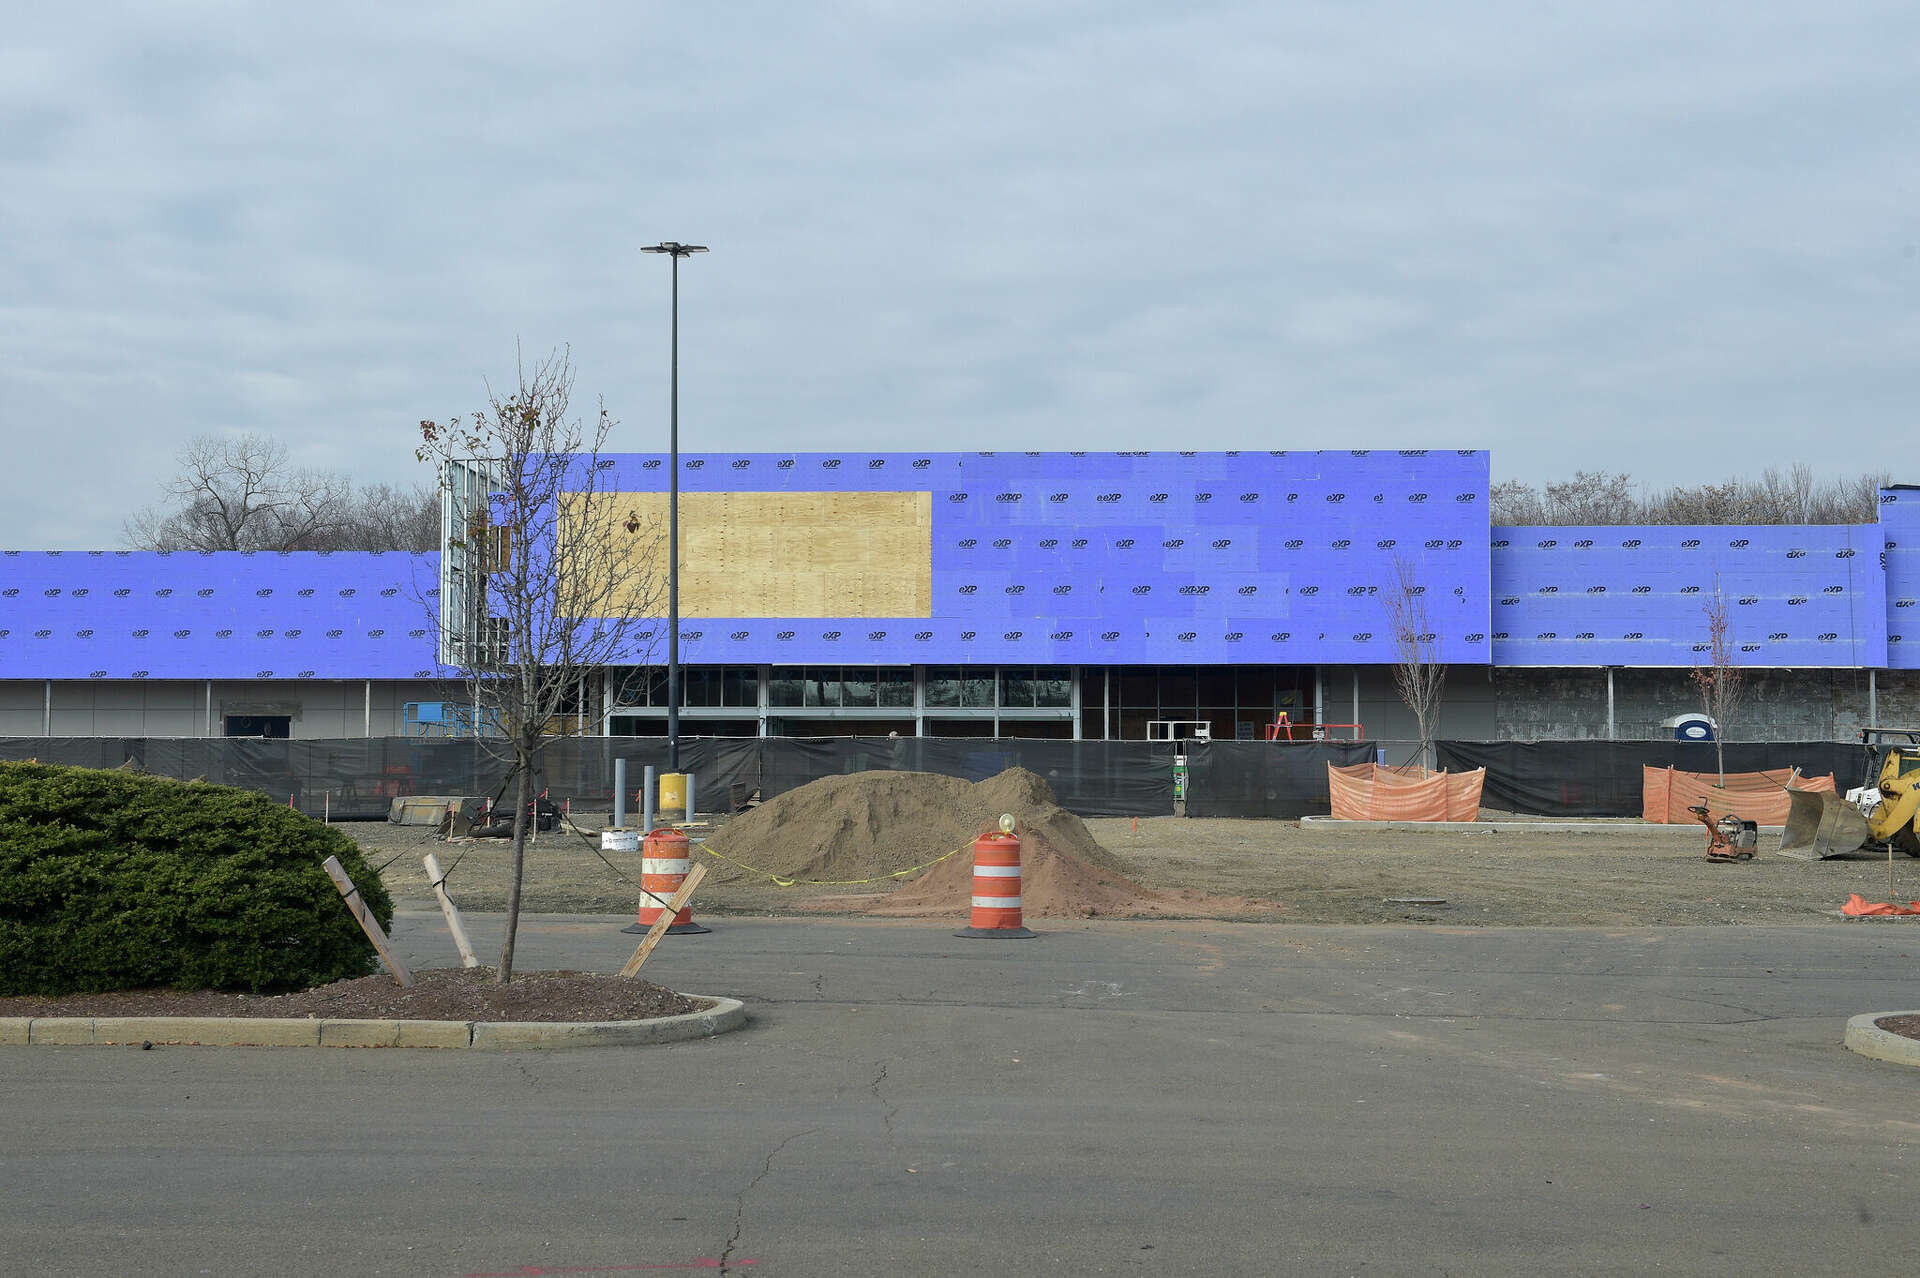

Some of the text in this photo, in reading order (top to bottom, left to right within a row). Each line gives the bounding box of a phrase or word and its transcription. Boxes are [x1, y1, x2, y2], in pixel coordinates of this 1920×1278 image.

[643, 460, 661, 468] eXP
[686, 460, 704, 468] eXP
[732, 460, 750, 468] eXP
[823, 460, 841, 468] eXP
[913, 460, 931, 468] eXP
[950, 493, 968, 502] eXP
[1050, 493, 1069, 502] eXP
[1150, 493, 1168, 502] eXP
[1240, 493, 1259, 502] eXP
[1326, 493, 1345, 502] eXP
[1409, 493, 1428, 502] eXP
[1456, 493, 1475, 502] eXP
[959, 539, 977, 548] eXP
[993, 539, 1011, 548] eXP
[1040, 539, 1058, 548] eXP
[1116, 539, 1134, 548] eXP
[1213, 539, 1232, 548] eXP
[1285, 539, 1304, 548] eXP
[1332, 539, 1351, 548] eXP
[1377, 539, 1396, 548] eXP
[1425, 539, 1444, 548] eXP
[1538, 539, 1557, 548] eXP
[1574, 539, 1593, 548] eXP
[1622, 539, 1641, 548] eXP
[1681, 539, 1700, 548] eXP
[1730, 539, 1749, 548] eXP
[3, 588, 20, 596] eXP
[45, 588, 62, 596] eXP
[72, 588, 89, 596] eXP
[114, 588, 131, 596] eXP
[156, 588, 173, 596] eXP
[198, 588, 215, 596] eXP
[257, 588, 274, 596] eXP
[298, 588, 315, 596] eXP
[339, 588, 356, 596] eXP
[381, 588, 398, 596] eXP
[959, 585, 978, 594] eXP
[1006, 585, 1025, 594] eXP
[1053, 585, 1072, 594] eXP
[1132, 585, 1151, 594] eXP
[1239, 586, 1257, 595] eXP
[1300, 586, 1318, 595] eXP
[1348, 586, 1366, 595] eXP
[1539, 586, 1558, 594] eXP
[1587, 586, 1606, 594] eXP
[1632, 586, 1651, 594] eXP
[1681, 586, 1700, 594] eXP
[1824, 586, 1843, 594] eXP
[35, 629, 52, 637] eXP
[77, 629, 94, 637] eXP
[132, 629, 149, 637] eXP
[174, 629, 191, 637] eXP
[216, 629, 233, 637] eXP
[257, 629, 274, 637] eXP
[285, 629, 302, 637] eXP
[326, 629, 343, 637] eXP
[368, 629, 385, 637] eXP
[409, 629, 426, 637] eXP
[731, 632, 749, 640] eXP
[777, 632, 795, 640] eXP
[823, 632, 841, 640] eXP
[869, 632, 887, 640] eXP
[915, 632, 933, 640] eXP
[1004, 632, 1022, 641] eXP
[1101, 632, 1120, 641] eXP
[1178, 632, 1197, 641] eXP
[1225, 632, 1244, 641] eXP
[1272, 632, 1291, 641] eXP
[1353, 632, 1372, 641] eXP
[1537, 632, 1556, 640] eXP
[1576, 632, 1595, 640] eXP
[1624, 632, 1643, 640] eXP
[1769, 632, 1788, 640] eXP
[1818, 632, 1837, 640] eXP
[1465, 633, 1484, 642] eXP
[90, 670, 107, 678] eXP
[132, 670, 149, 678] eXP
[257, 670, 274, 678] eXP
[298, 670, 315, 678] eXP
[415, 670, 432, 678] eXP
